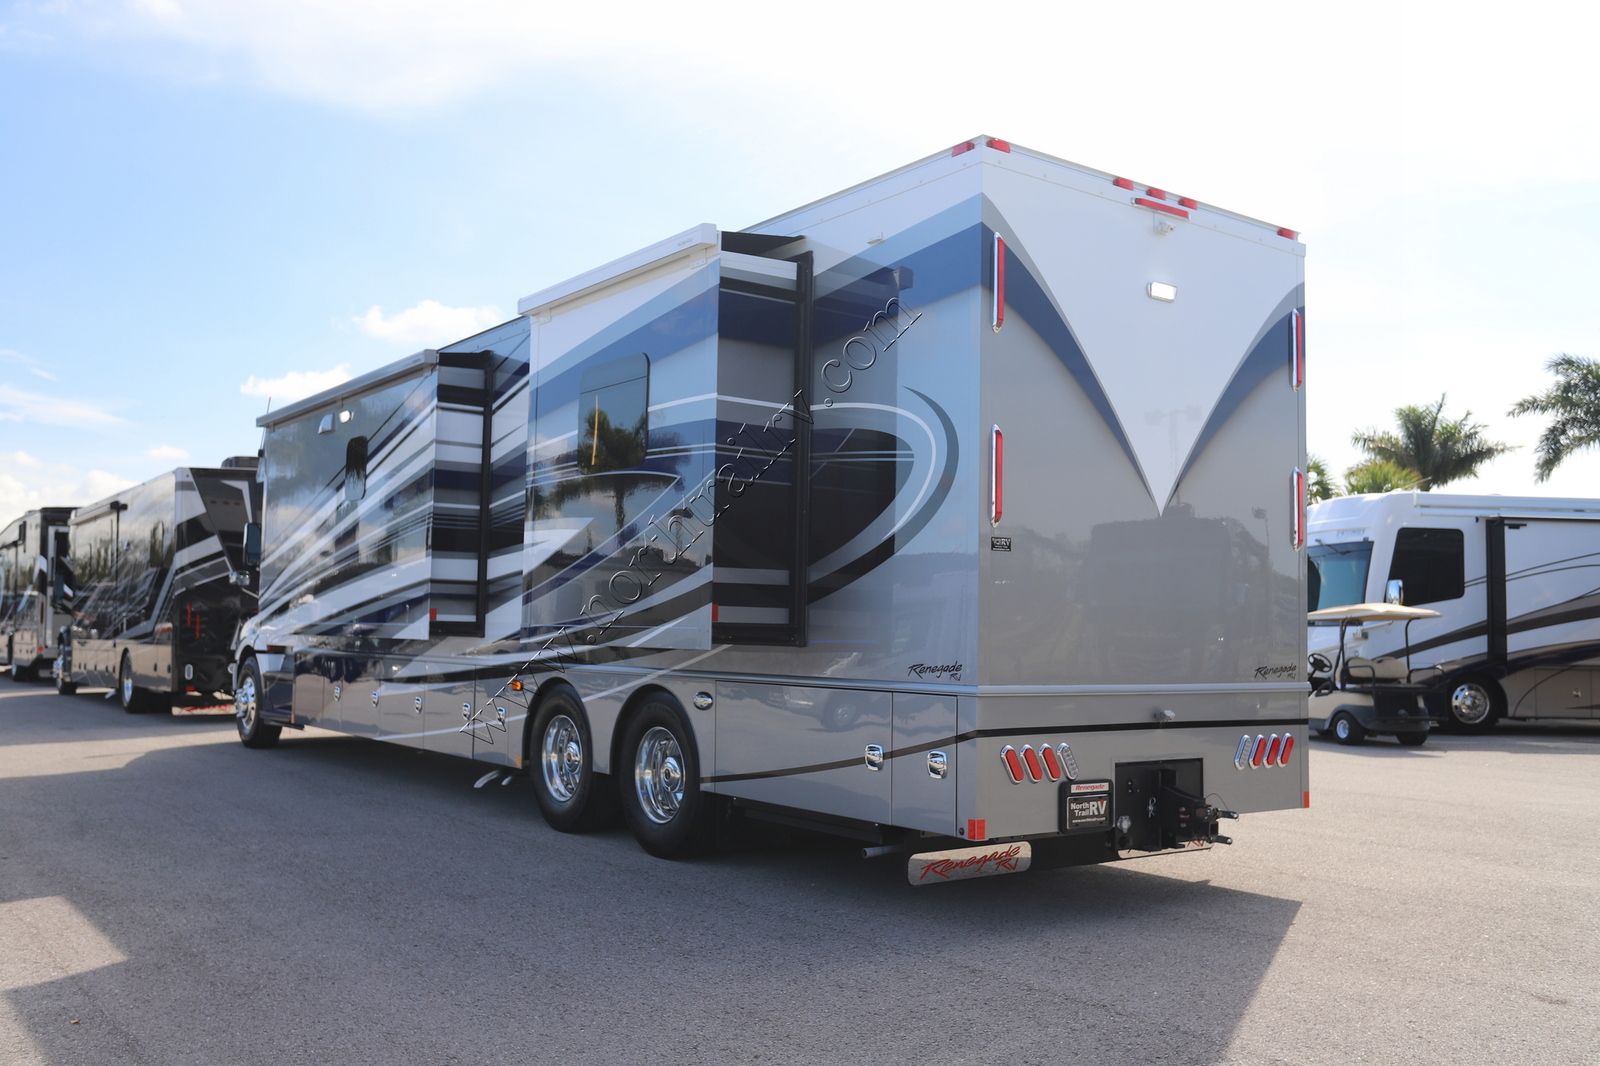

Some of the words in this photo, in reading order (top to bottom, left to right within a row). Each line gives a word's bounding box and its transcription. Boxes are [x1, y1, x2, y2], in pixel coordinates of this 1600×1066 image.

[908, 660, 962, 679] Renegade
[1070, 802, 1089, 810] North
[1090, 800, 1107, 815] RV
[920, 845, 1020, 880] Renegade
[996, 858, 1019, 871] RV
